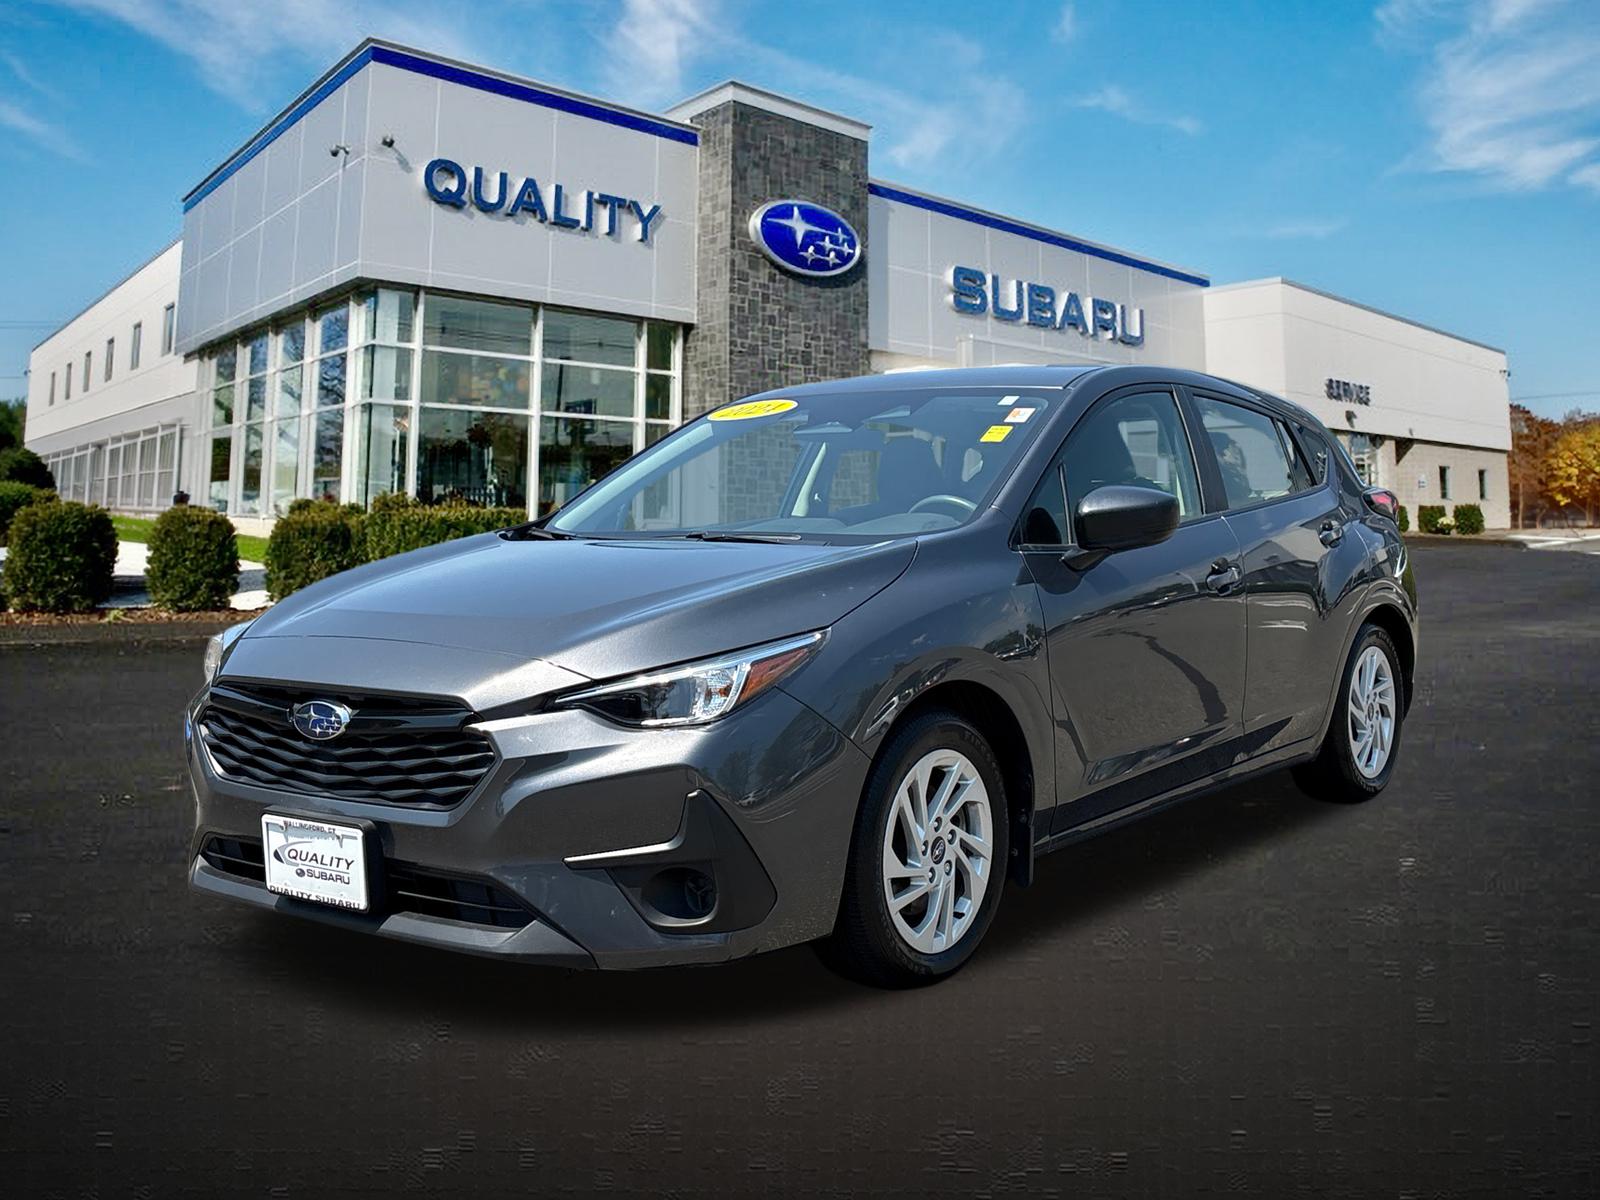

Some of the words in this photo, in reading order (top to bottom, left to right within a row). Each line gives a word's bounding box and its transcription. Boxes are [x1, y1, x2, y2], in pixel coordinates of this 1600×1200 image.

[424, 158, 661, 242] QUALITY
[951, 265, 1145, 347] SUBARU
[1325, 378, 1370, 406] SERVICE
[287, 848, 354, 870] QUALITY
[306, 869, 350, 885] SUBARU
[269, 885, 312, 900] QUALITY
[315, 895, 361, 910] SUBARU
